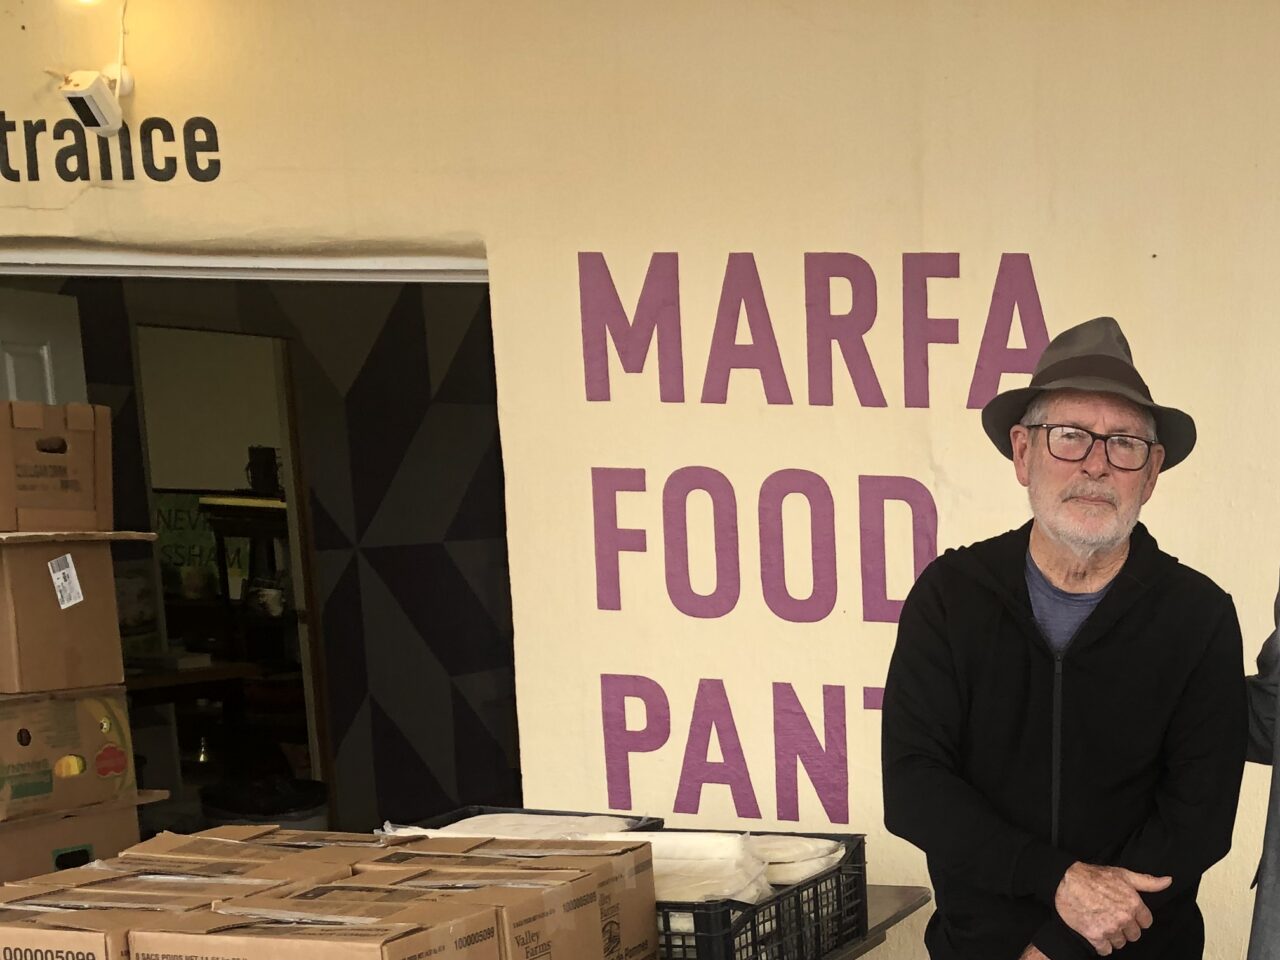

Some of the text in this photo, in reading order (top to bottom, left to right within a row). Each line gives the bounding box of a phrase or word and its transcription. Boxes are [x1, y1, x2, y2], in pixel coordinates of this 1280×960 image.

[578, 252, 1051, 409] MARFA
[591, 466, 937, 623] FOOD
[600, 674, 883, 824] PAN
[514, 930, 541, 948] Valley
[525, 941, 551, 960] Farms
